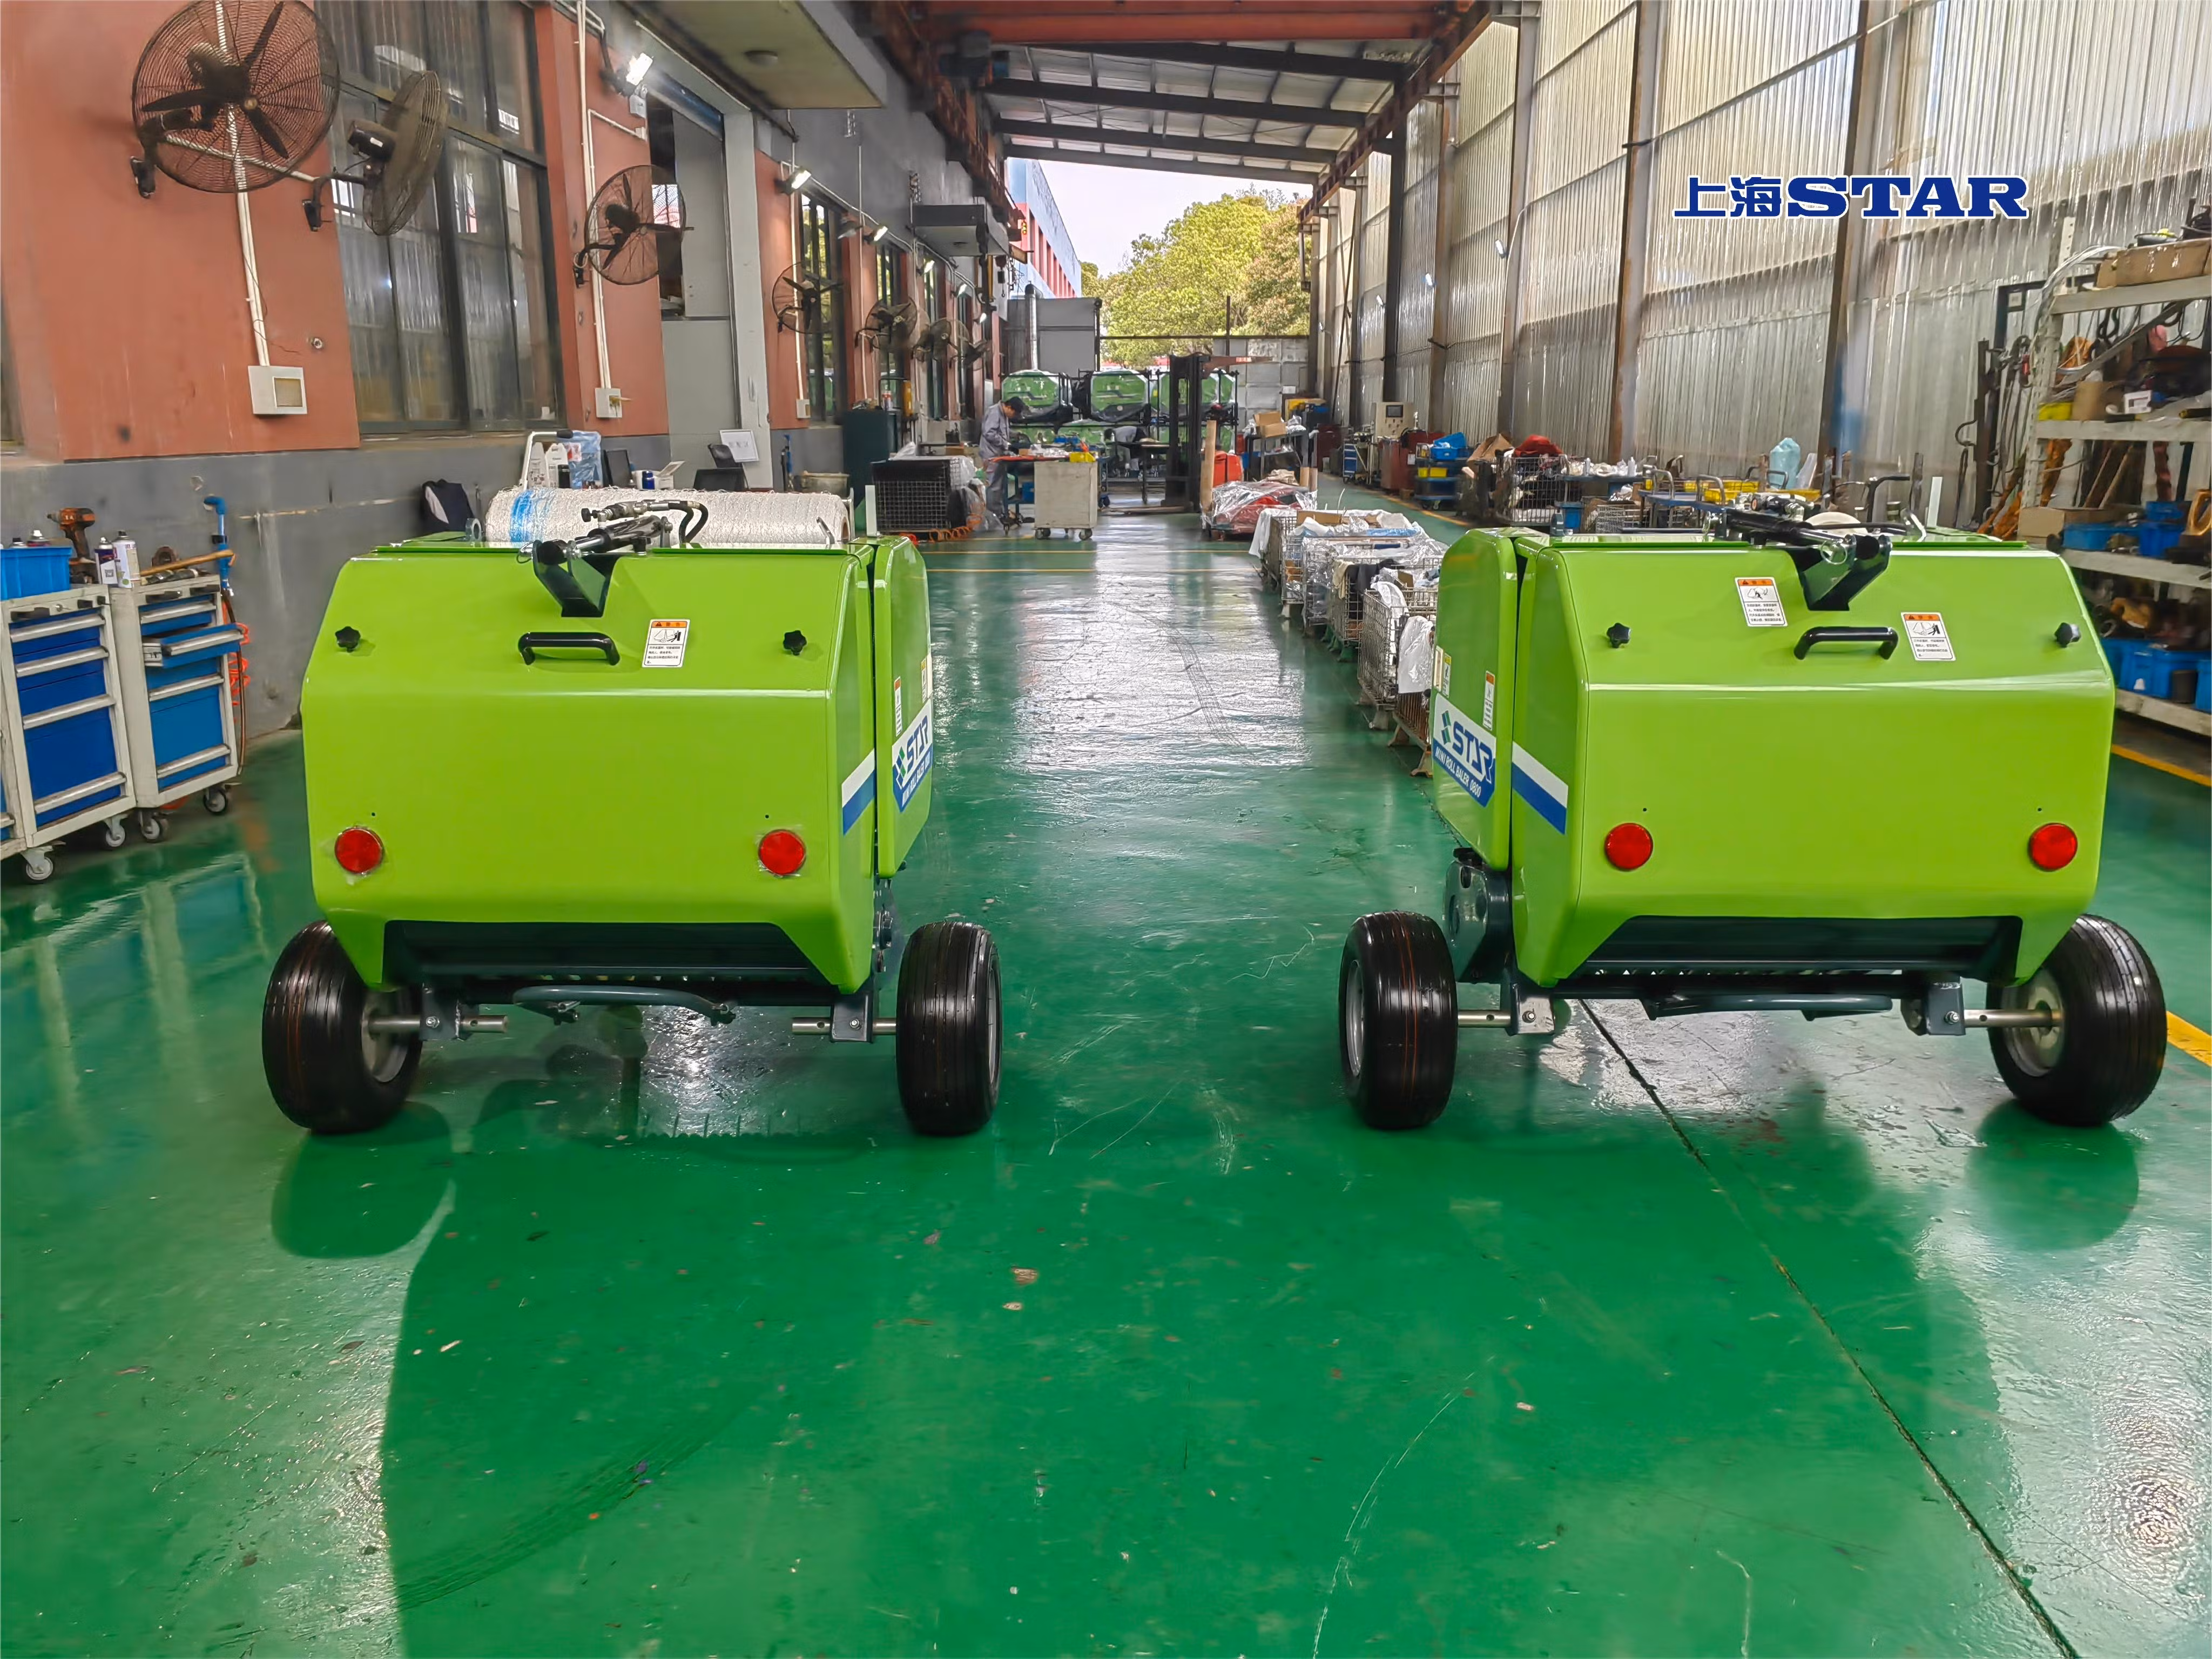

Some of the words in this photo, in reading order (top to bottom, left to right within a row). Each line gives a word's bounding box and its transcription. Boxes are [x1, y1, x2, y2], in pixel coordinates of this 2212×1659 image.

[1435, 746, 1446, 765] MINI
[1446, 756, 1455, 774] ROLL
[1455, 765, 1469, 787] BALER
